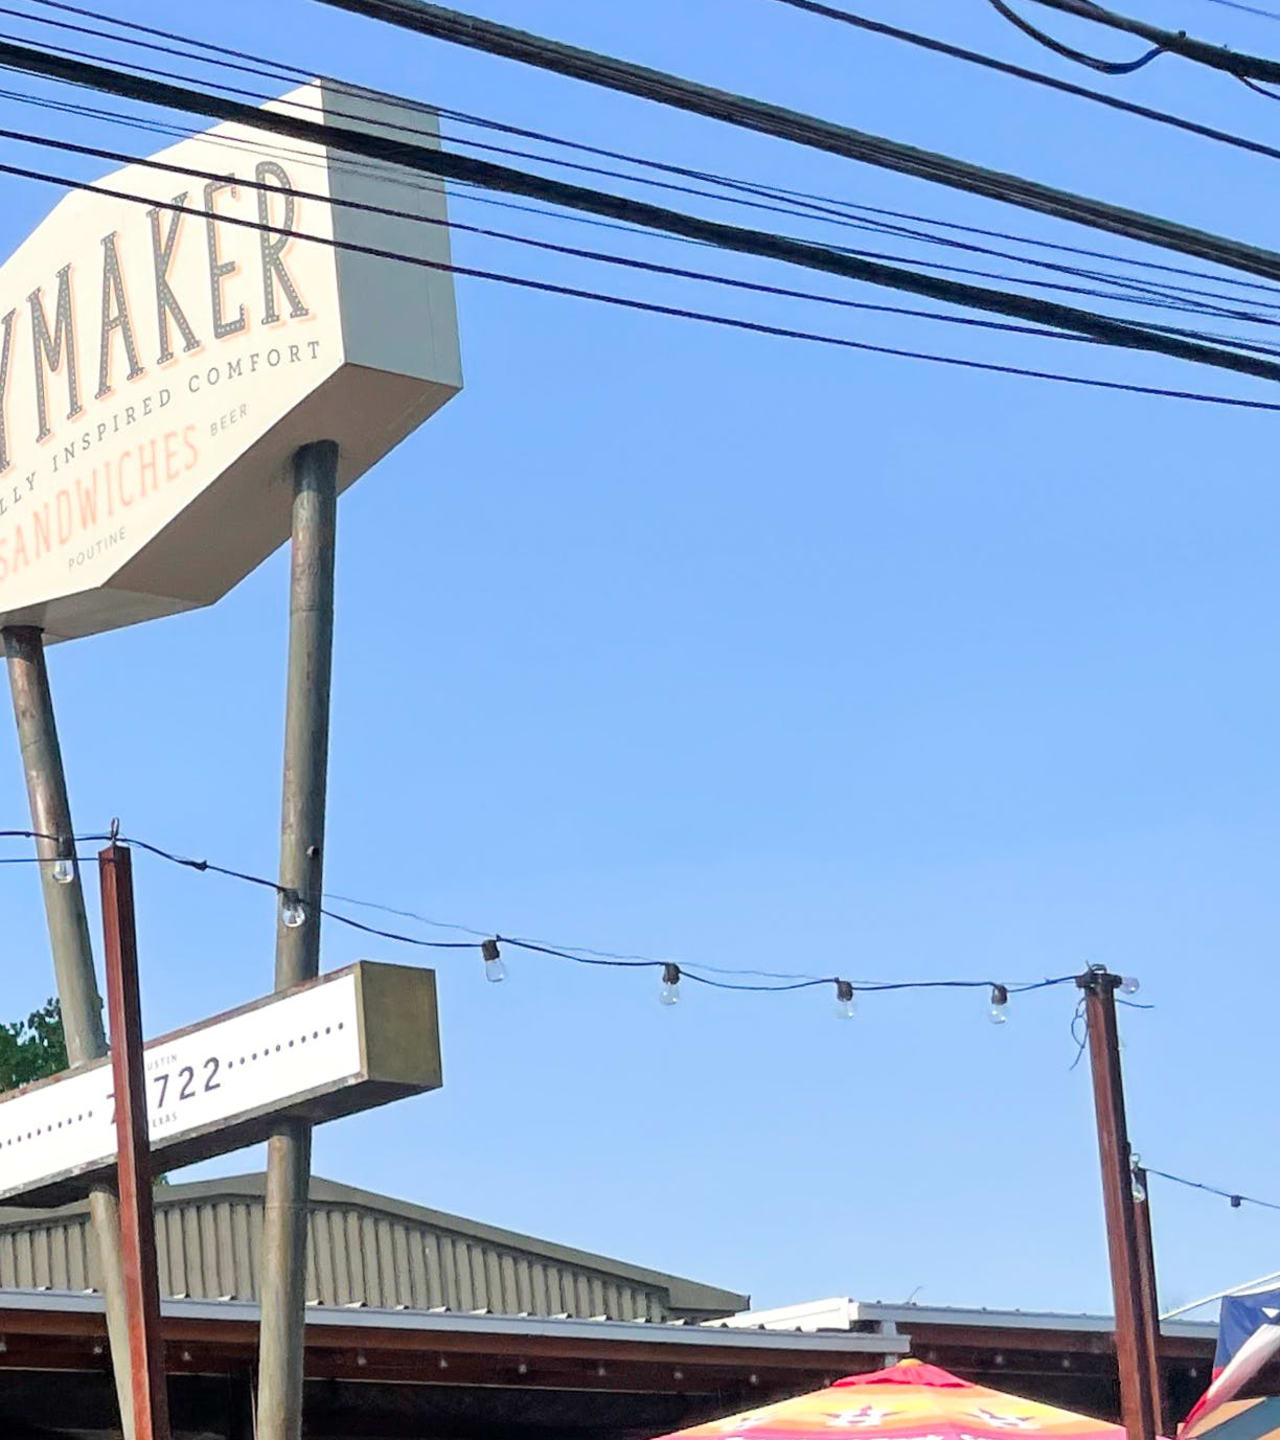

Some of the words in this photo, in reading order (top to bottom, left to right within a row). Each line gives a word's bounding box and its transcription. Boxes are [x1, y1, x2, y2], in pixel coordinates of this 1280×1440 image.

[52, 388, 172, 473] INSPIRED
[187, 340, 321, 394] COMFORT
[209, 403, 249, 437] BEER
[67, 526, 127, 573] POUTINE
[146, 1053, 178, 1072] USTIN
[151, 1111, 178, 1128] EXAS
